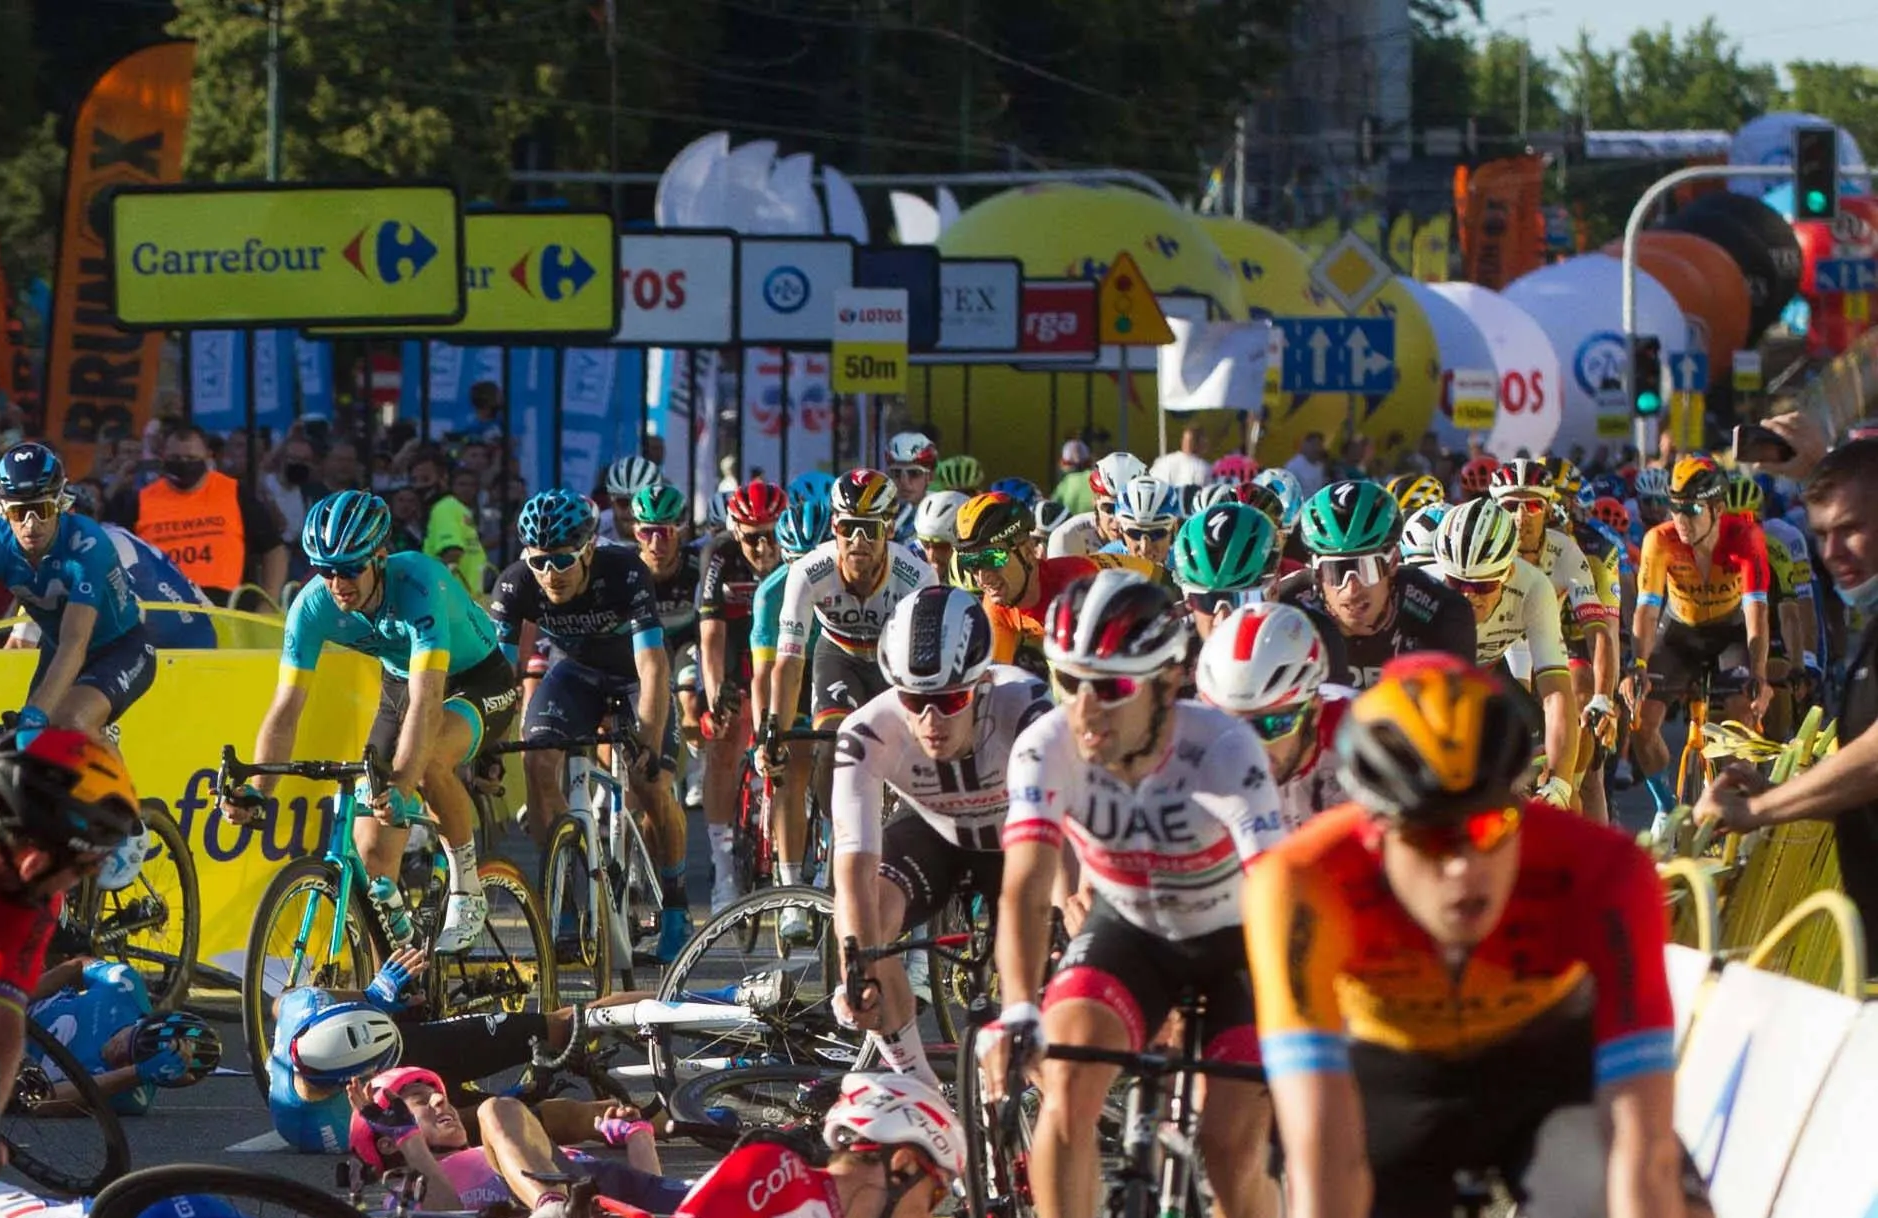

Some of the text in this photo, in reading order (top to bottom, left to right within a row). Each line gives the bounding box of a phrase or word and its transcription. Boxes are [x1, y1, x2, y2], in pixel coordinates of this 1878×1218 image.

[131, 238, 326, 276] Carrefour
[859, 308, 904, 324] LOTOS
[844, 355, 897, 379] 50m
[153, 515, 226, 533] STEWARD
[805, 555, 835, 578] BORA
[893, 556, 921, 580] BORA
[1086, 795, 1196, 844] UAE
